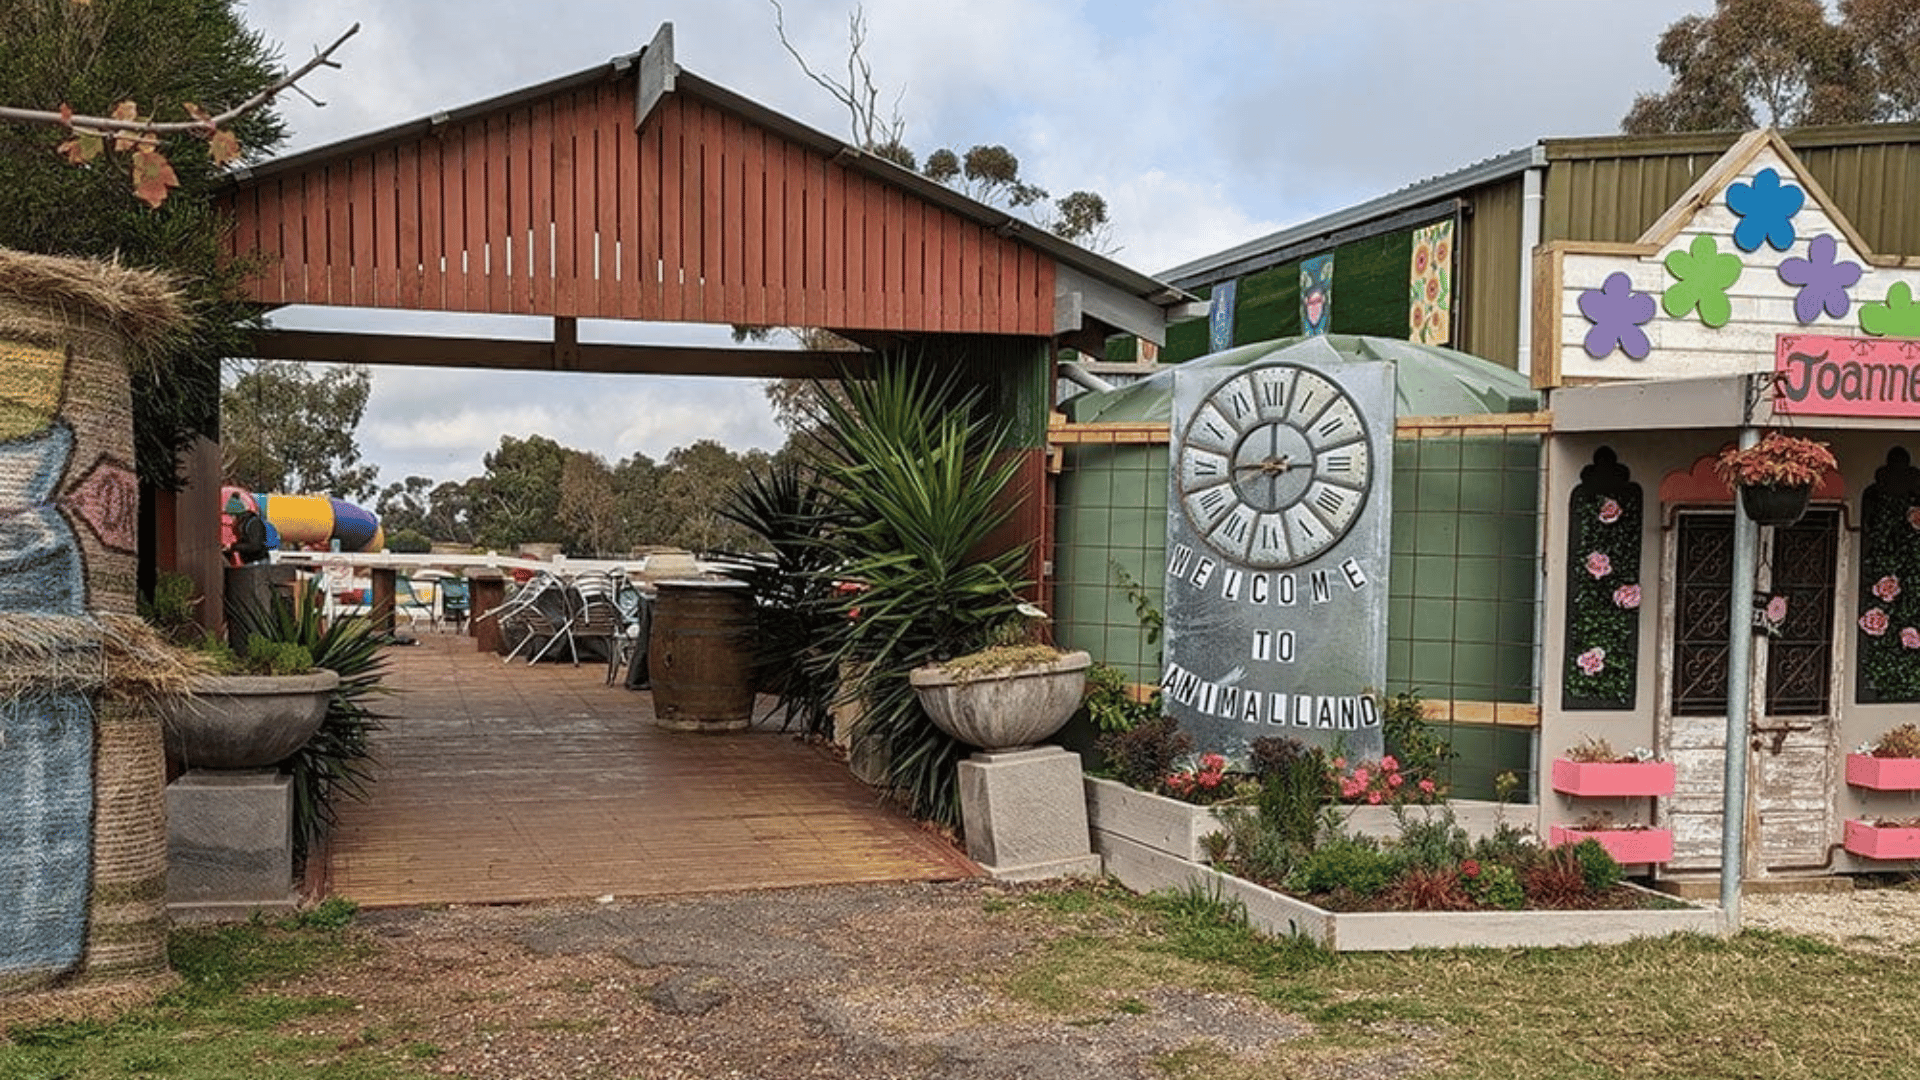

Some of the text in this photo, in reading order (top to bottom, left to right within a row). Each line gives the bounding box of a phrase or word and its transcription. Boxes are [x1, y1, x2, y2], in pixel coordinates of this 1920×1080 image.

[1171, 546, 1365, 603] WELCOME
[1255, 631, 1293, 661] TO
[1162, 666, 1378, 728] ANIMALLAND
